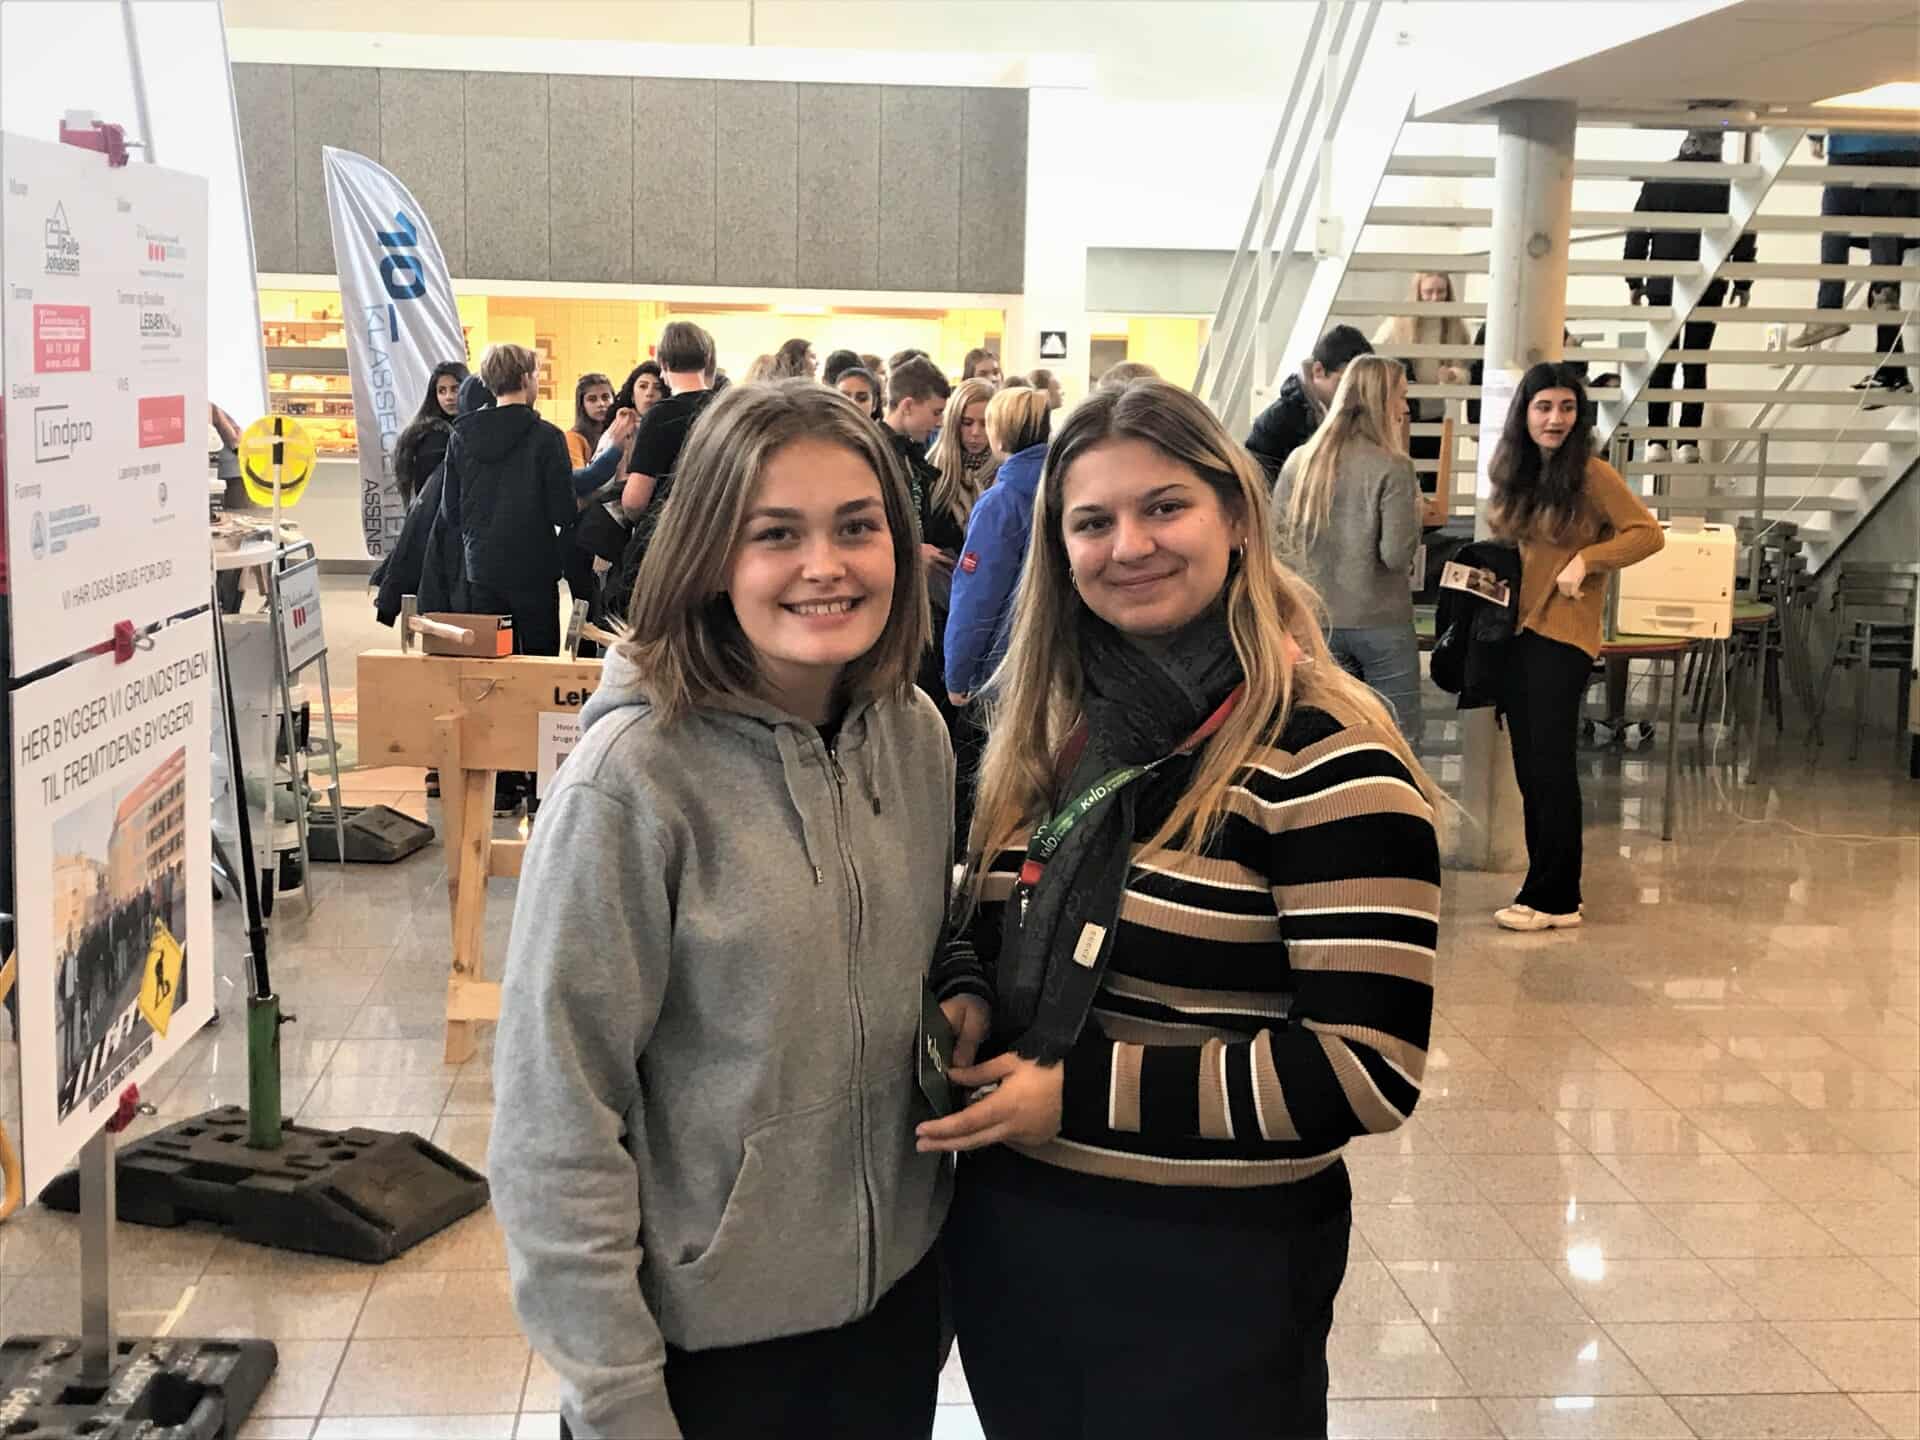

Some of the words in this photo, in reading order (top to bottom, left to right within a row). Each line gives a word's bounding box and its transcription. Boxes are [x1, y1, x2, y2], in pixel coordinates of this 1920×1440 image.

[41, 416, 92, 454] Lindpro
[363, 479, 383, 556] ASSENS
[20, 724, 51, 768] HER
[52, 696, 107, 750] BYGGER
[108, 687, 122, 719] VI
[124, 649, 209, 712] GRUNDSTENEN
[41, 773, 62, 807] TIL
[63, 726, 142, 796] FREMTIDENS
